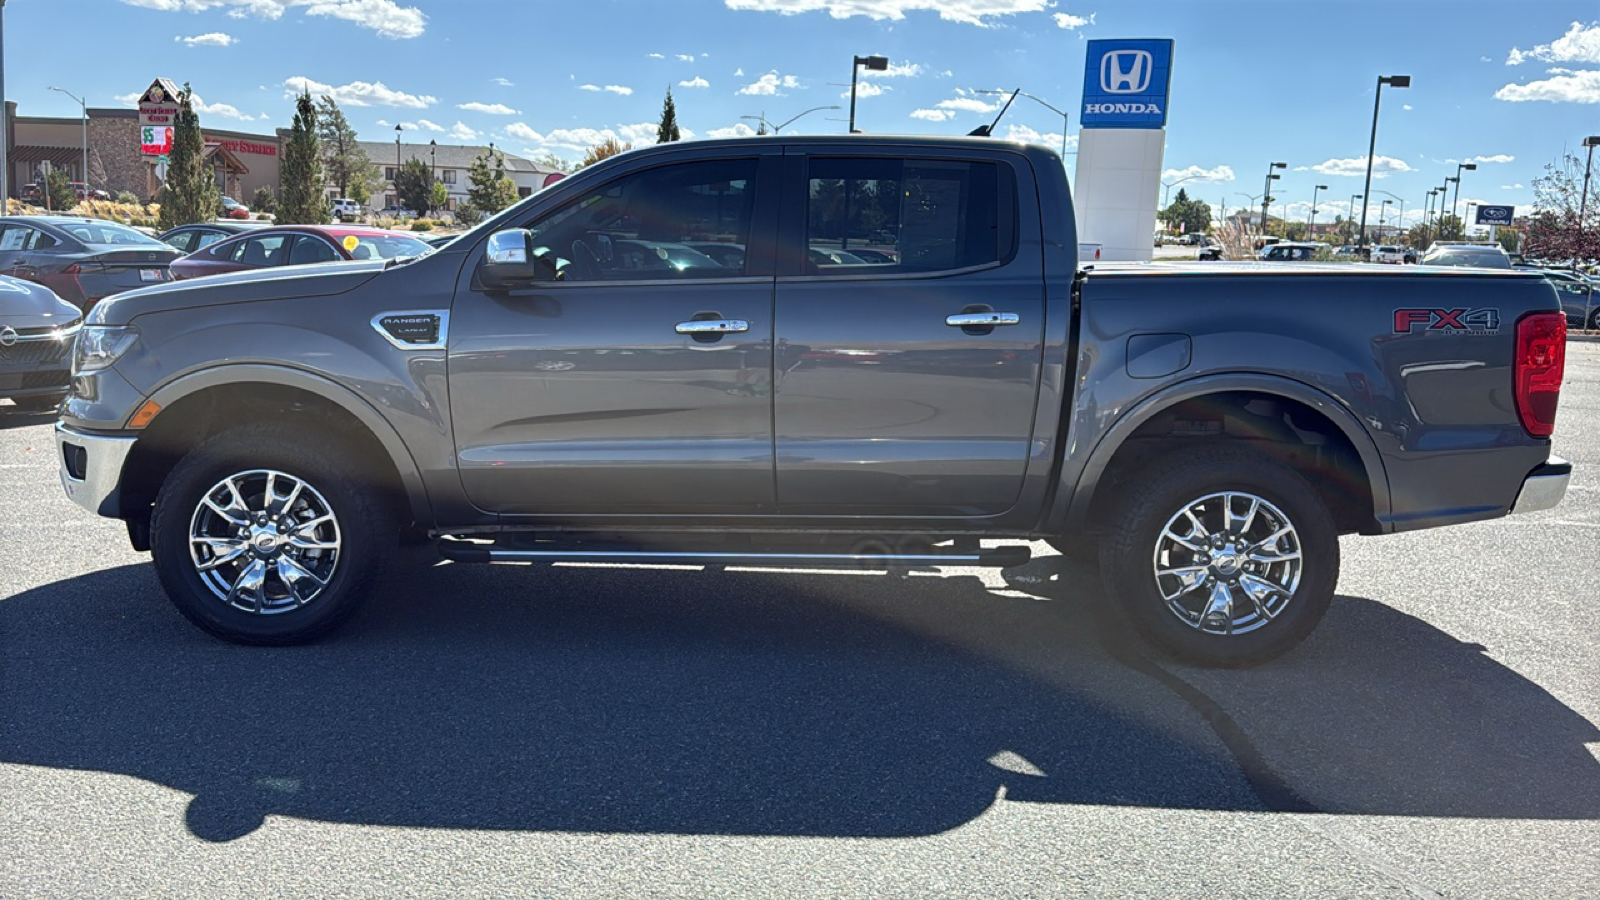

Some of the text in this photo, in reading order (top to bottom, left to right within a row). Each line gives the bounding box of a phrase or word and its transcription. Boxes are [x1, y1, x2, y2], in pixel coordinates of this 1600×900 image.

[1085, 103, 1161, 114] HONDA
[240, 140, 276, 155] STRIKE
[1393, 307, 1500, 335] FX4
